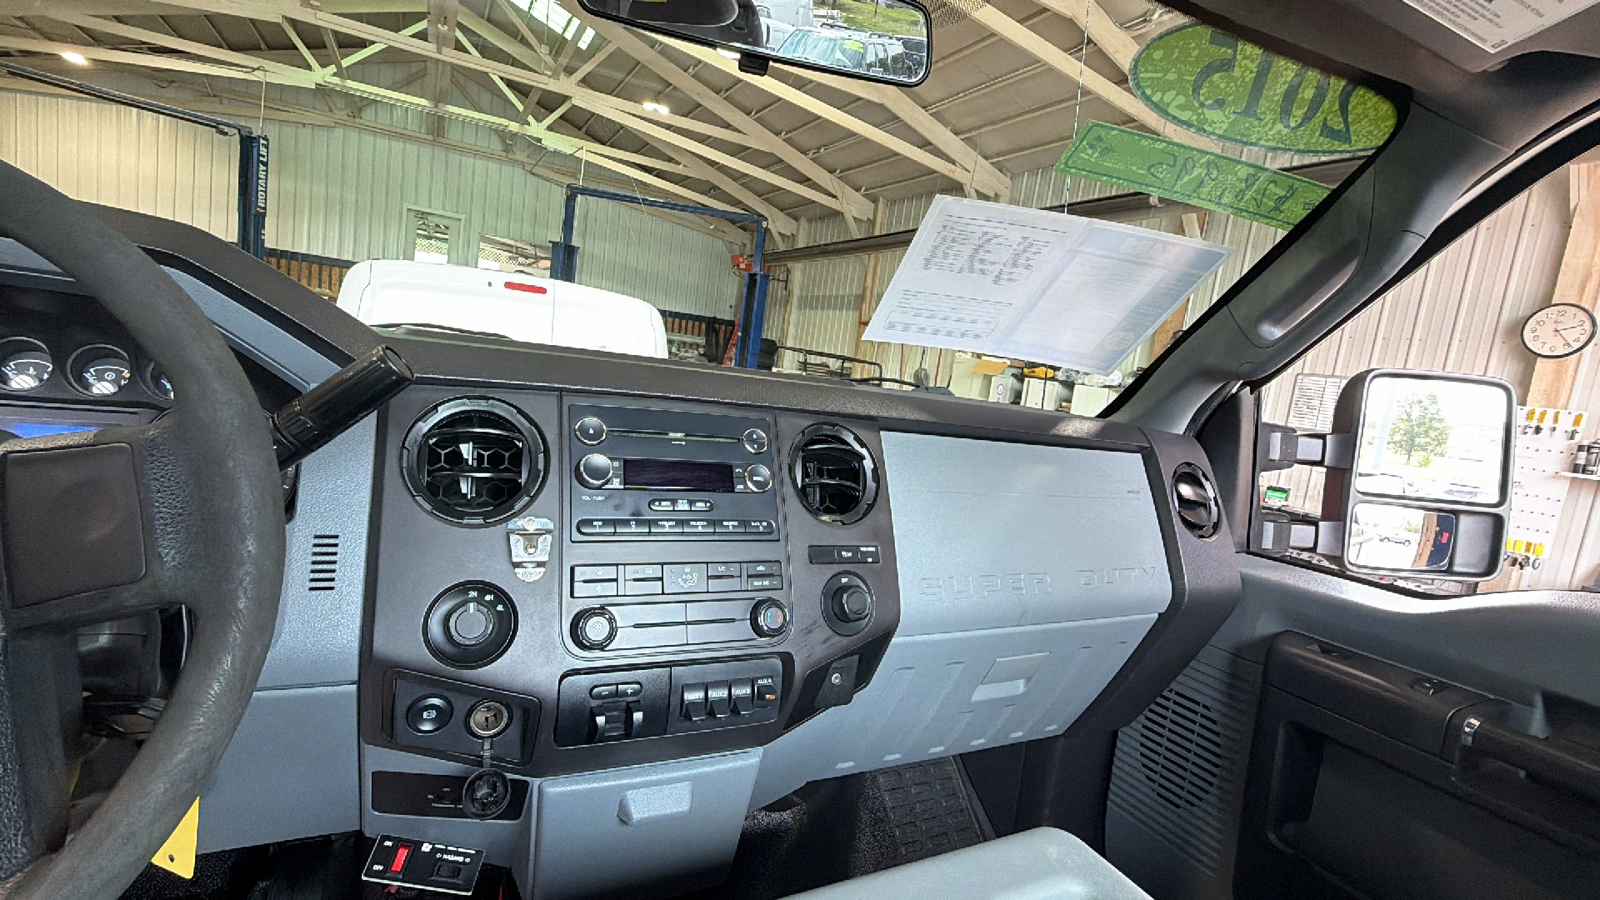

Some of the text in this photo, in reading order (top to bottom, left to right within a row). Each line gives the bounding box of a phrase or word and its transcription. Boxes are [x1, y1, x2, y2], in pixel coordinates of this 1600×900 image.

[257, 137, 268, 208] ROTARY LIFT
[1556, 309, 1567, 317] 12
[1535, 319, 1546, 327] 10
[1529, 326, 1538, 334] 9
[1540, 341, 1547, 349] 7
[918, 566, 1157, 601] SUPER DUTY
[467, 590, 478, 598] 2H
